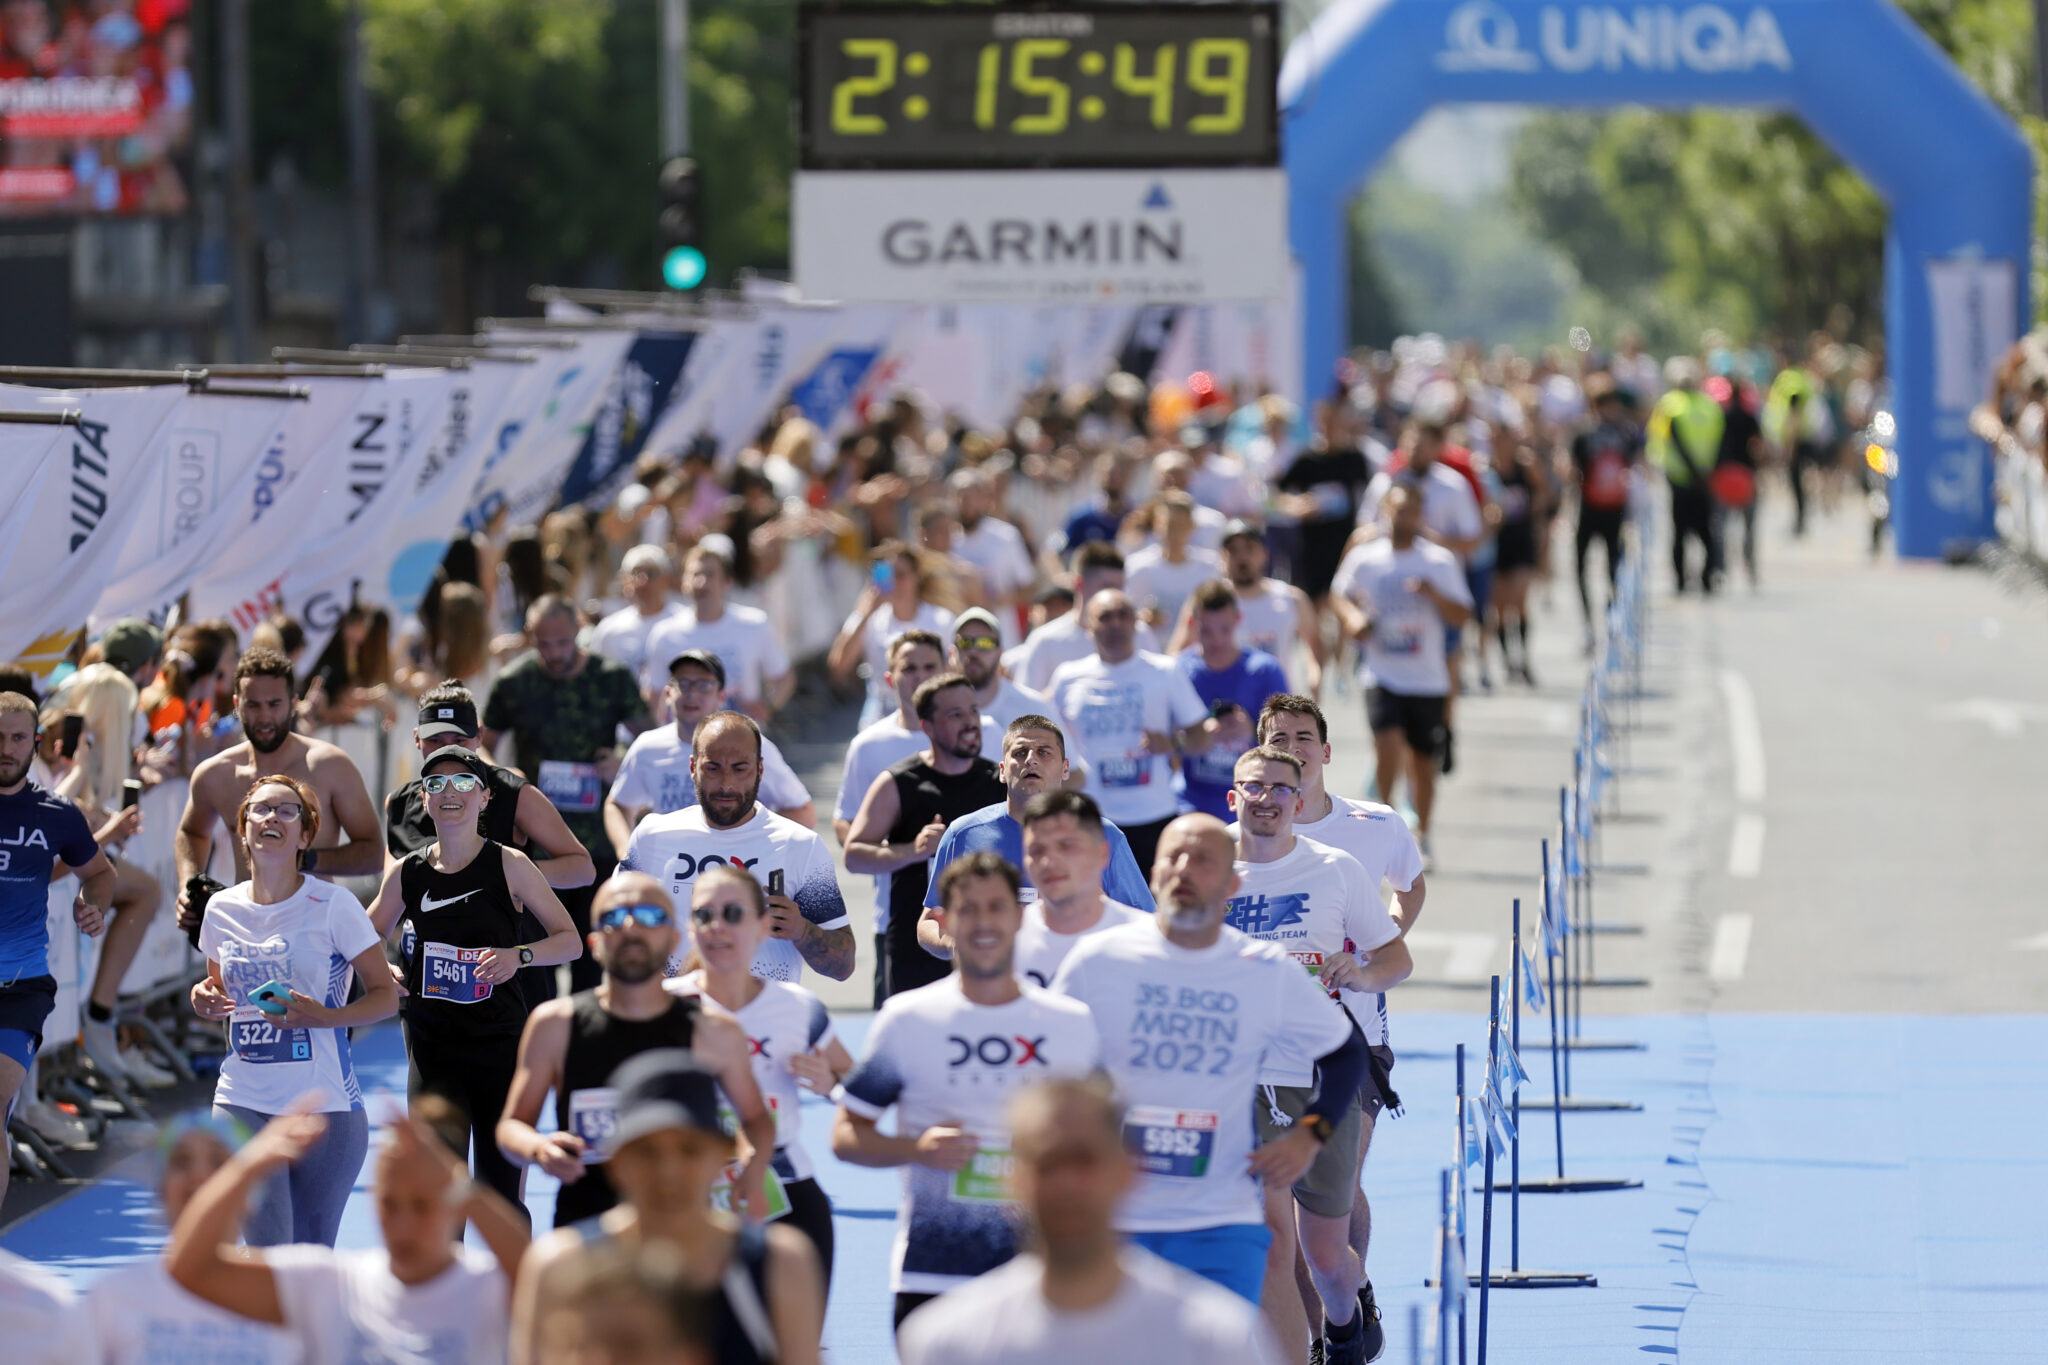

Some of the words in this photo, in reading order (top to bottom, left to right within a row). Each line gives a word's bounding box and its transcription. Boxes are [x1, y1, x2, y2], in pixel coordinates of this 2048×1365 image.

[1540, 4, 1794, 74] UNIQA
[881, 217, 1183, 267] GARMIN
[1281, 930, 1308, 939] TEAM
[433, 959, 467, 984] 5461
[1131, 1008, 1239, 1044] MRTN
[1130, 1038, 1234, 1077] 2022
